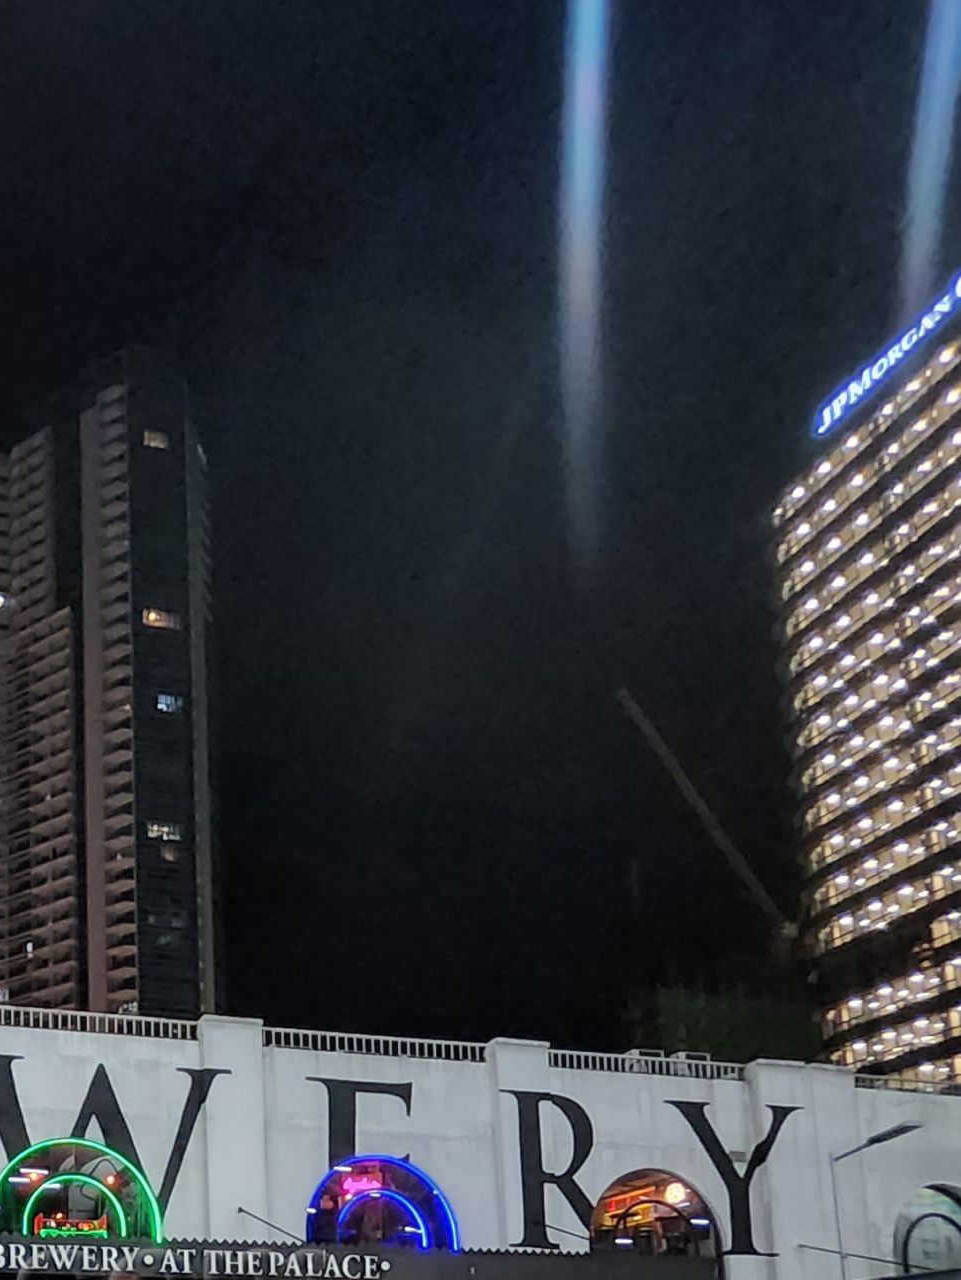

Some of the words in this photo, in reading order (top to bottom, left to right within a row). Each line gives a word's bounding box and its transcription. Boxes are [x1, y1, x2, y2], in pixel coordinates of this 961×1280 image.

[817, 293, 953, 434] JPMORGAN
[159, 1248, 197, 1274] AT
[203, 1248, 263, 1276] THE
[268, 1251, 381, 1280] PALACE
